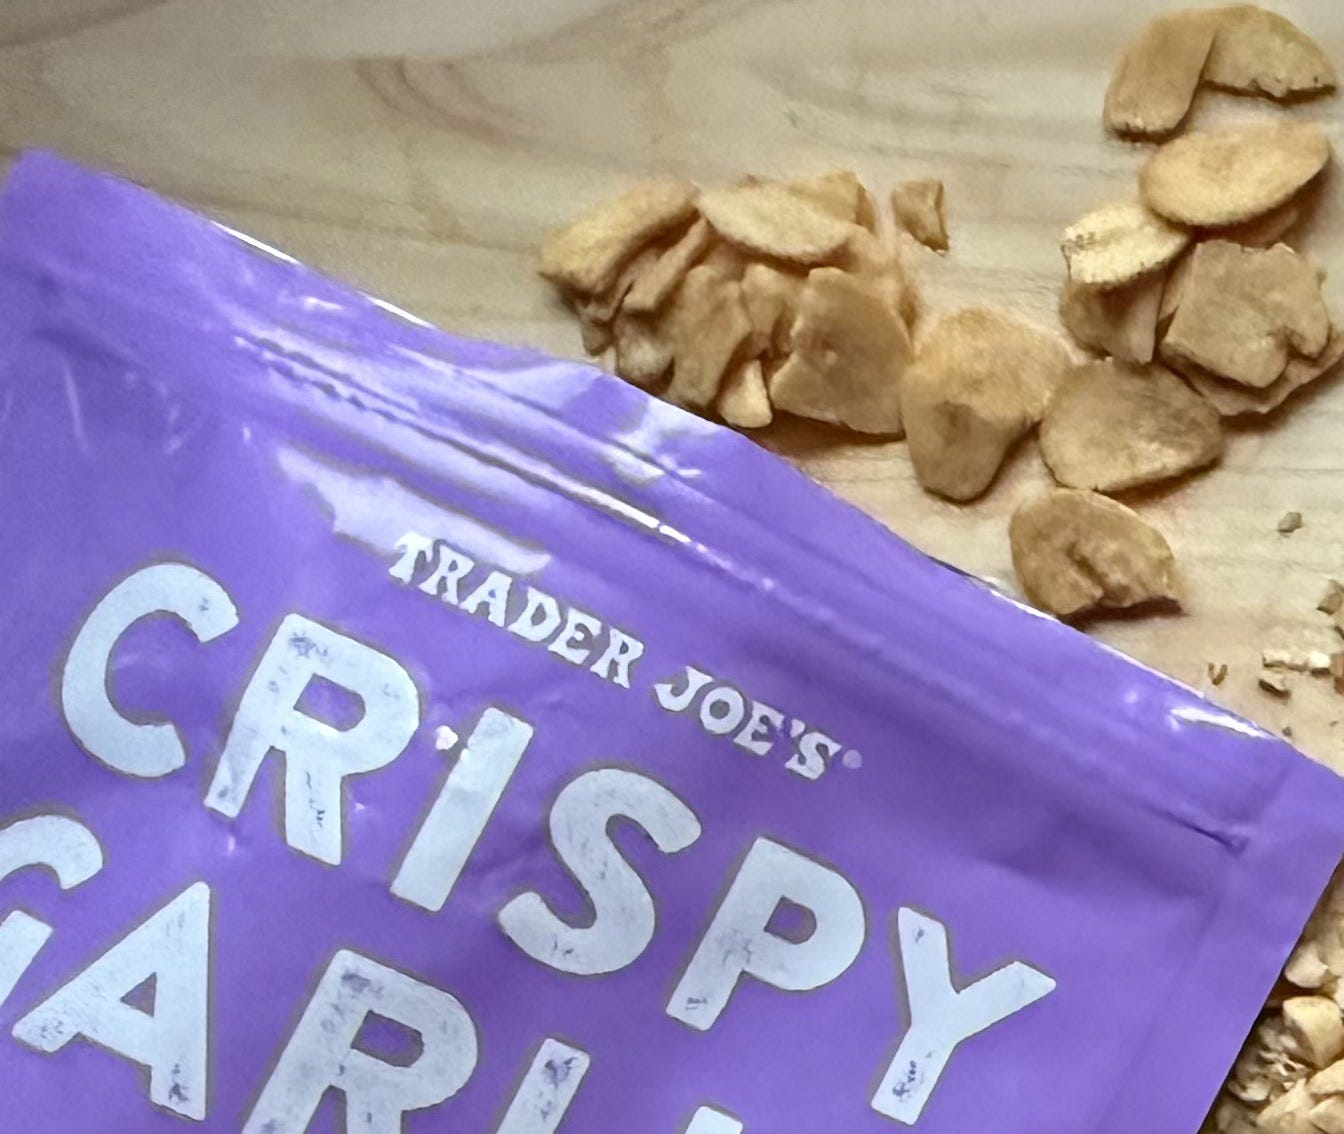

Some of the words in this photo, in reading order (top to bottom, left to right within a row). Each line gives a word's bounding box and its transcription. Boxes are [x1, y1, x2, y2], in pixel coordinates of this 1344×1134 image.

[61, 562, 1056, 1126] CRISPY
[387, 532, 646, 689] TRADER
[653, 665, 842, 780] JOE'S
